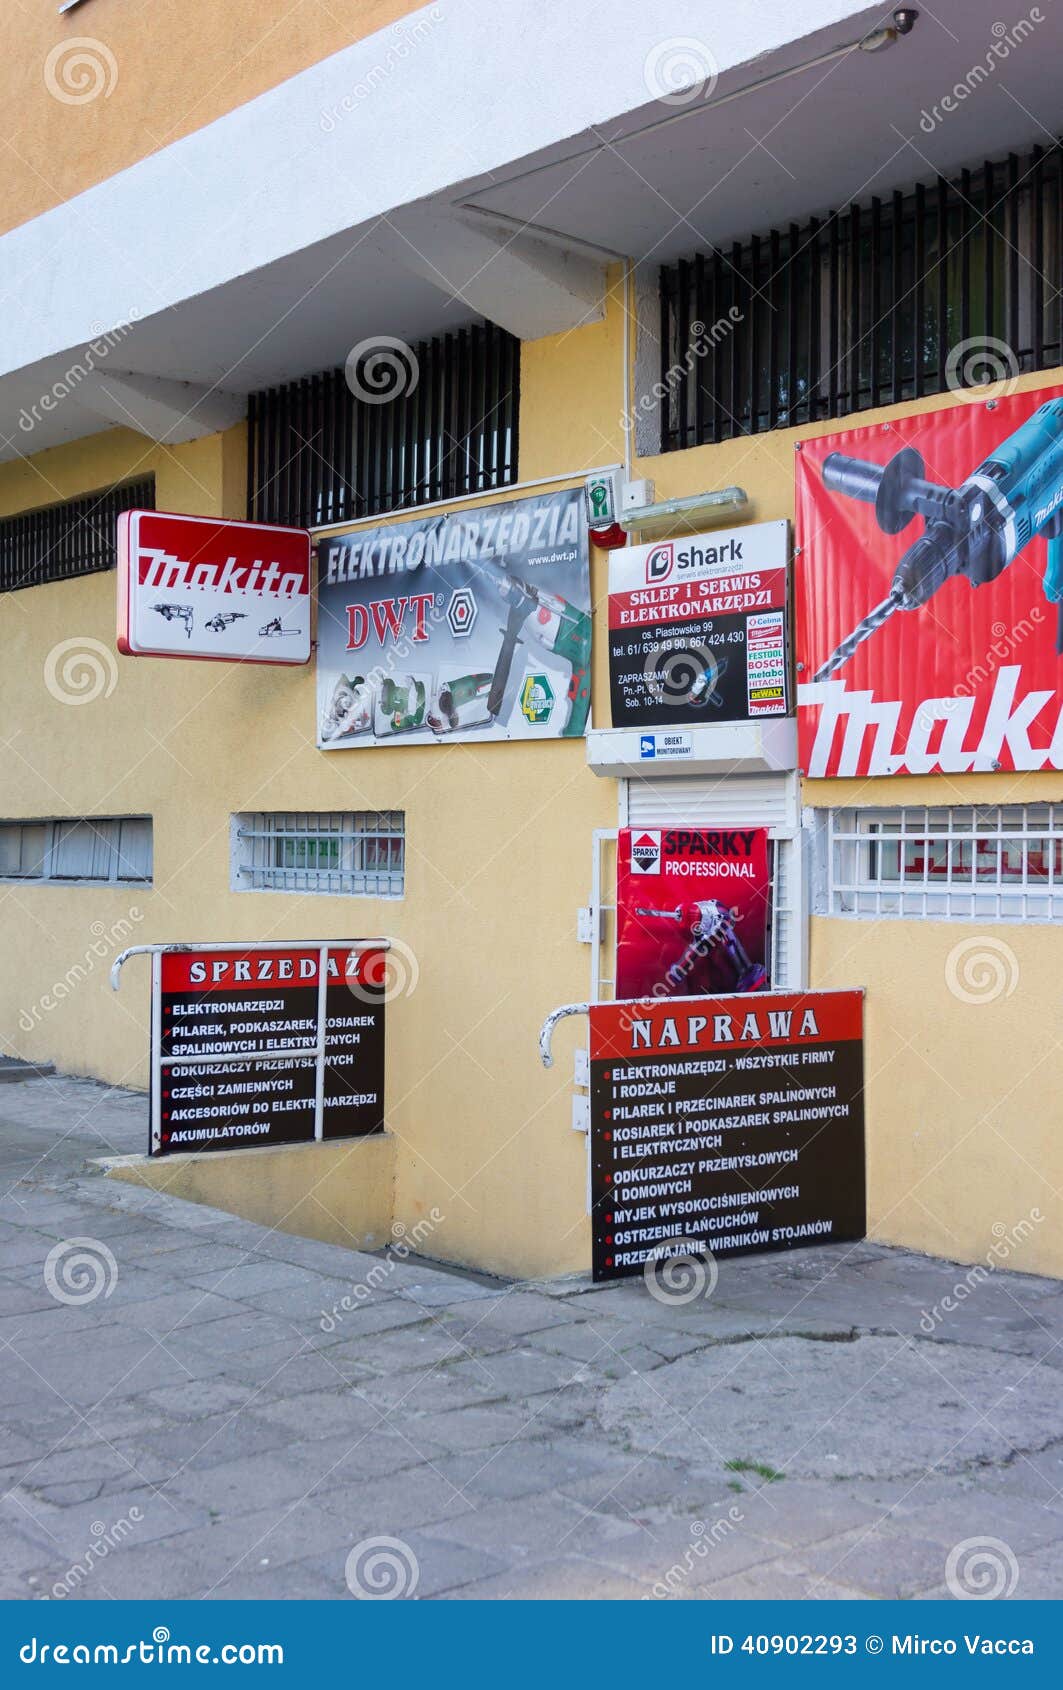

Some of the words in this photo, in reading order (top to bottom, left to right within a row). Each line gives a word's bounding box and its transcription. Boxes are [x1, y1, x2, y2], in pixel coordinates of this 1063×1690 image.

[528, 550, 578, 566] www.dwt.pl
[677, 539, 743, 570] shark
[138, 547, 305, 600] makita
[630, 586, 679, 606] SKLEP
[686, 584, 691, 598] i
[700, 574, 761, 596] SERWIS
[620, 590, 772, 624] ELEKTRONARZĘDZI
[346, 592, 435, 651] DWT
[642, 631, 653, 640] os.
[655, 624, 702, 638] Piastowskie
[703, 621, 713, 632] 99
[613, 645, 626, 656] tel.
[628, 644, 641, 655] 61/
[643, 642, 659, 653] 639
[660, 640, 672, 651] 49
[690, 636, 706, 647] 667
[708, 634, 725, 645] 424
[727, 631, 744, 642] 430
[748, 650, 783, 660] FESTOOL
[748, 659, 783, 669] BOSCH
[749, 669, 783, 679] metabo
[618, 670, 670, 684] ZAPRASZAMY
[749, 679, 783, 688] HITACHI
[625, 698, 641, 708] Sob.
[644, 696, 663, 706] 10-14
[797, 664, 1063, 778] mak
[664, 736, 683, 745] OBIEKT
[632, 847, 660, 857] SPARKY
[664, 830, 757, 857] SPARKY
[665, 861, 756, 879] PROFESSIONAL
[189, 951, 361, 983] SPRZEDAŻ
[172, 1000, 285, 1016] ELEKTRONARZĘDZI
[172, 1024, 227, 1037] PILAREK,
[230, 1019, 318, 1035] PODKASZAREK,
[631, 1008, 819, 1049] NAPRAWA
[172, 1041, 256, 1056] SPALINOWYCH
[259, 1041, 263, 1050] I
[267, 1034, 360, 1049] ELEKTRYZNYCH
[171, 1063, 252, 1077] ODKURZACZY
[255, 1054, 354, 1072] PRZEMYSŁWYCH
[612, 1060, 726, 1081] ELEKTRONARZĘDZI
[735, 1054, 799, 1071] WSZYSTKIE
[802, 1050, 835, 1065] FIRMY
[171, 1084, 214, 1100] CZĘŚCI
[217, 1079, 293, 1094] ZAMIENNYCH
[612, 1086, 617, 1099] I
[620, 1081, 676, 1098] RODZAJE
[170, 1103, 250, 1121] AKCESORIÓW
[253, 1103, 269, 1113] DO
[272, 1093, 377, 1112] ELEKTRNARZĘDZI
[612, 1103, 665, 1121] PILAREK
[668, 1102, 672, 1114] I
[676, 1094, 756, 1114] PRZECINAREK
[759, 1086, 836, 1105] SPALINOWYCH
[170, 1122, 271, 1142] AKUMULATORÓW
[612, 1123, 675, 1142] KOSIAREK
[678, 1122, 682, 1135] I
[686, 1112, 770, 1133] PODKASZAREK
[773, 1105, 849, 1123] SPALINOWYCH
[613, 1147, 617, 1160] I
[621, 1135, 722, 1158] ELEKTRYCZNYCH
[613, 1163, 695, 1185] ODKURZACZY
[699, 1149, 799, 1173] PRZEMYSŁOWYCH
[613, 1190, 618, 1202] I
[621, 1180, 692, 1200] DOMOWYCH
[614, 1207, 657, 1224] MYJEK
[659, 1185, 800, 1217] WYSOKOCIŚNIENIOWYCH
[614, 1225, 683, 1245] OSTRZENIE
[684, 1211, 759, 1234] ŁAŃCUCHÓW
[614, 1242, 707, 1267] PRZEZWAJANIE
[709, 1229, 769, 1250] WIRNIKÓW
[772, 1220, 833, 1241] STOJANÓW
